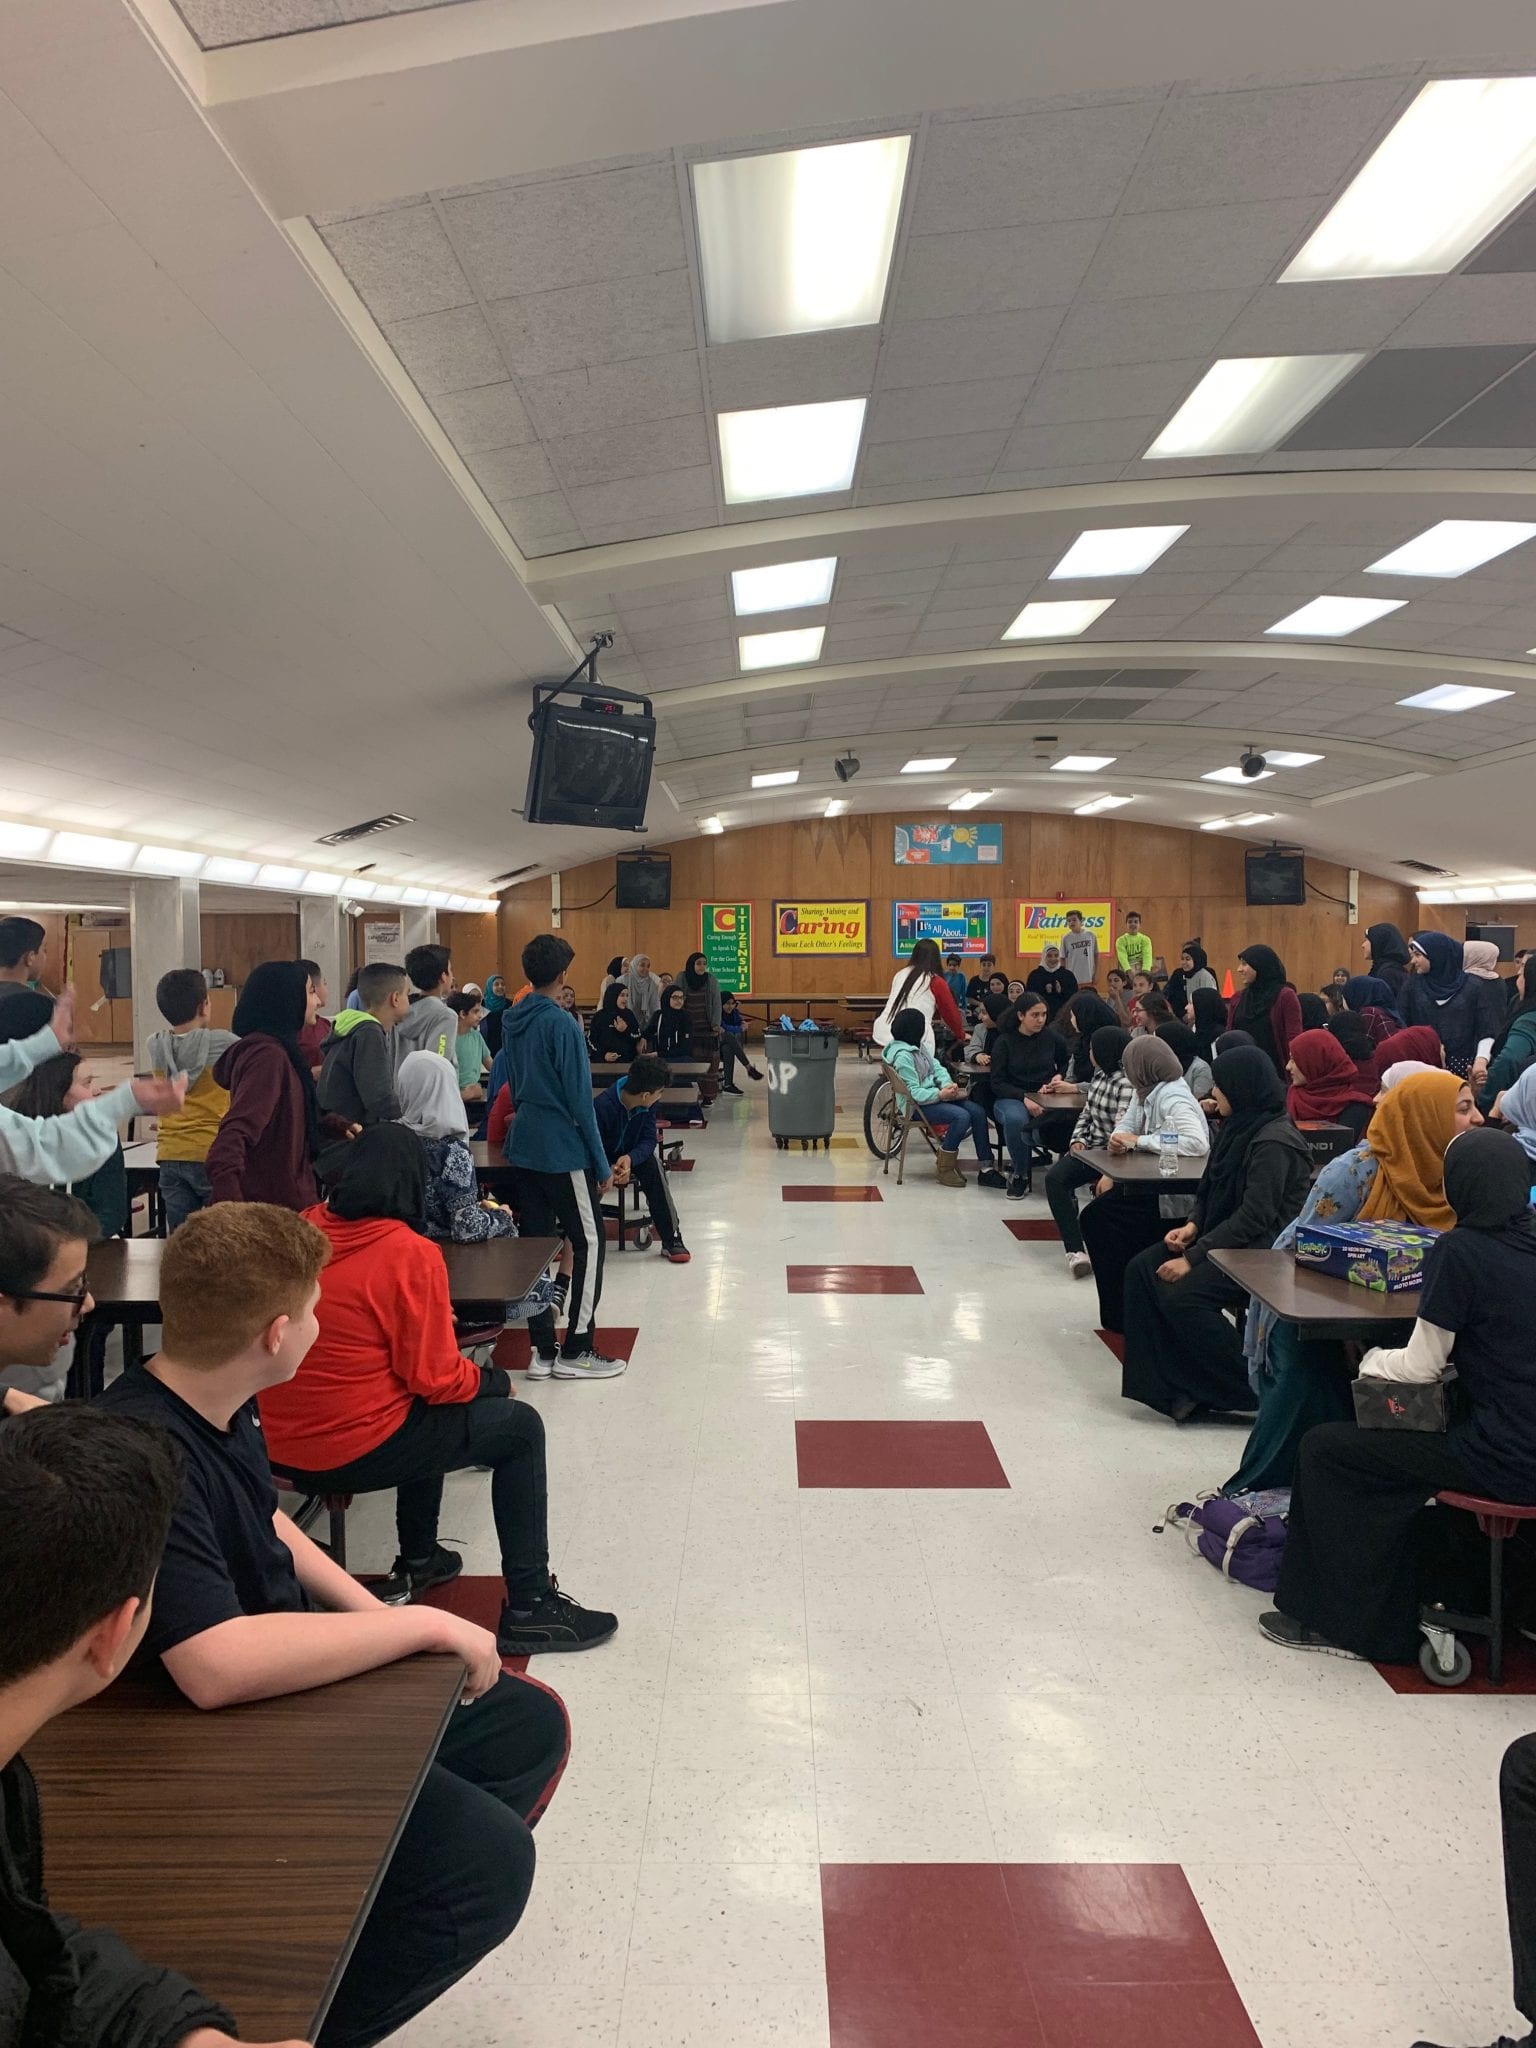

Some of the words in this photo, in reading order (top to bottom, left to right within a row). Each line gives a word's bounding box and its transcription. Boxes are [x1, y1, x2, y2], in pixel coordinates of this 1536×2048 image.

[848, 907, 859, 915] and
[779, 908, 861, 939] Caring
[919, 920, 932, 931] It's
[932, 924, 943, 934] All
[782, 940, 799, 948] About
[799, 940, 815, 948] Each
[815, 940, 837, 948] Other's
[838, 940, 863, 949] Feelings
[1082, 947, 1089, 957] 4
